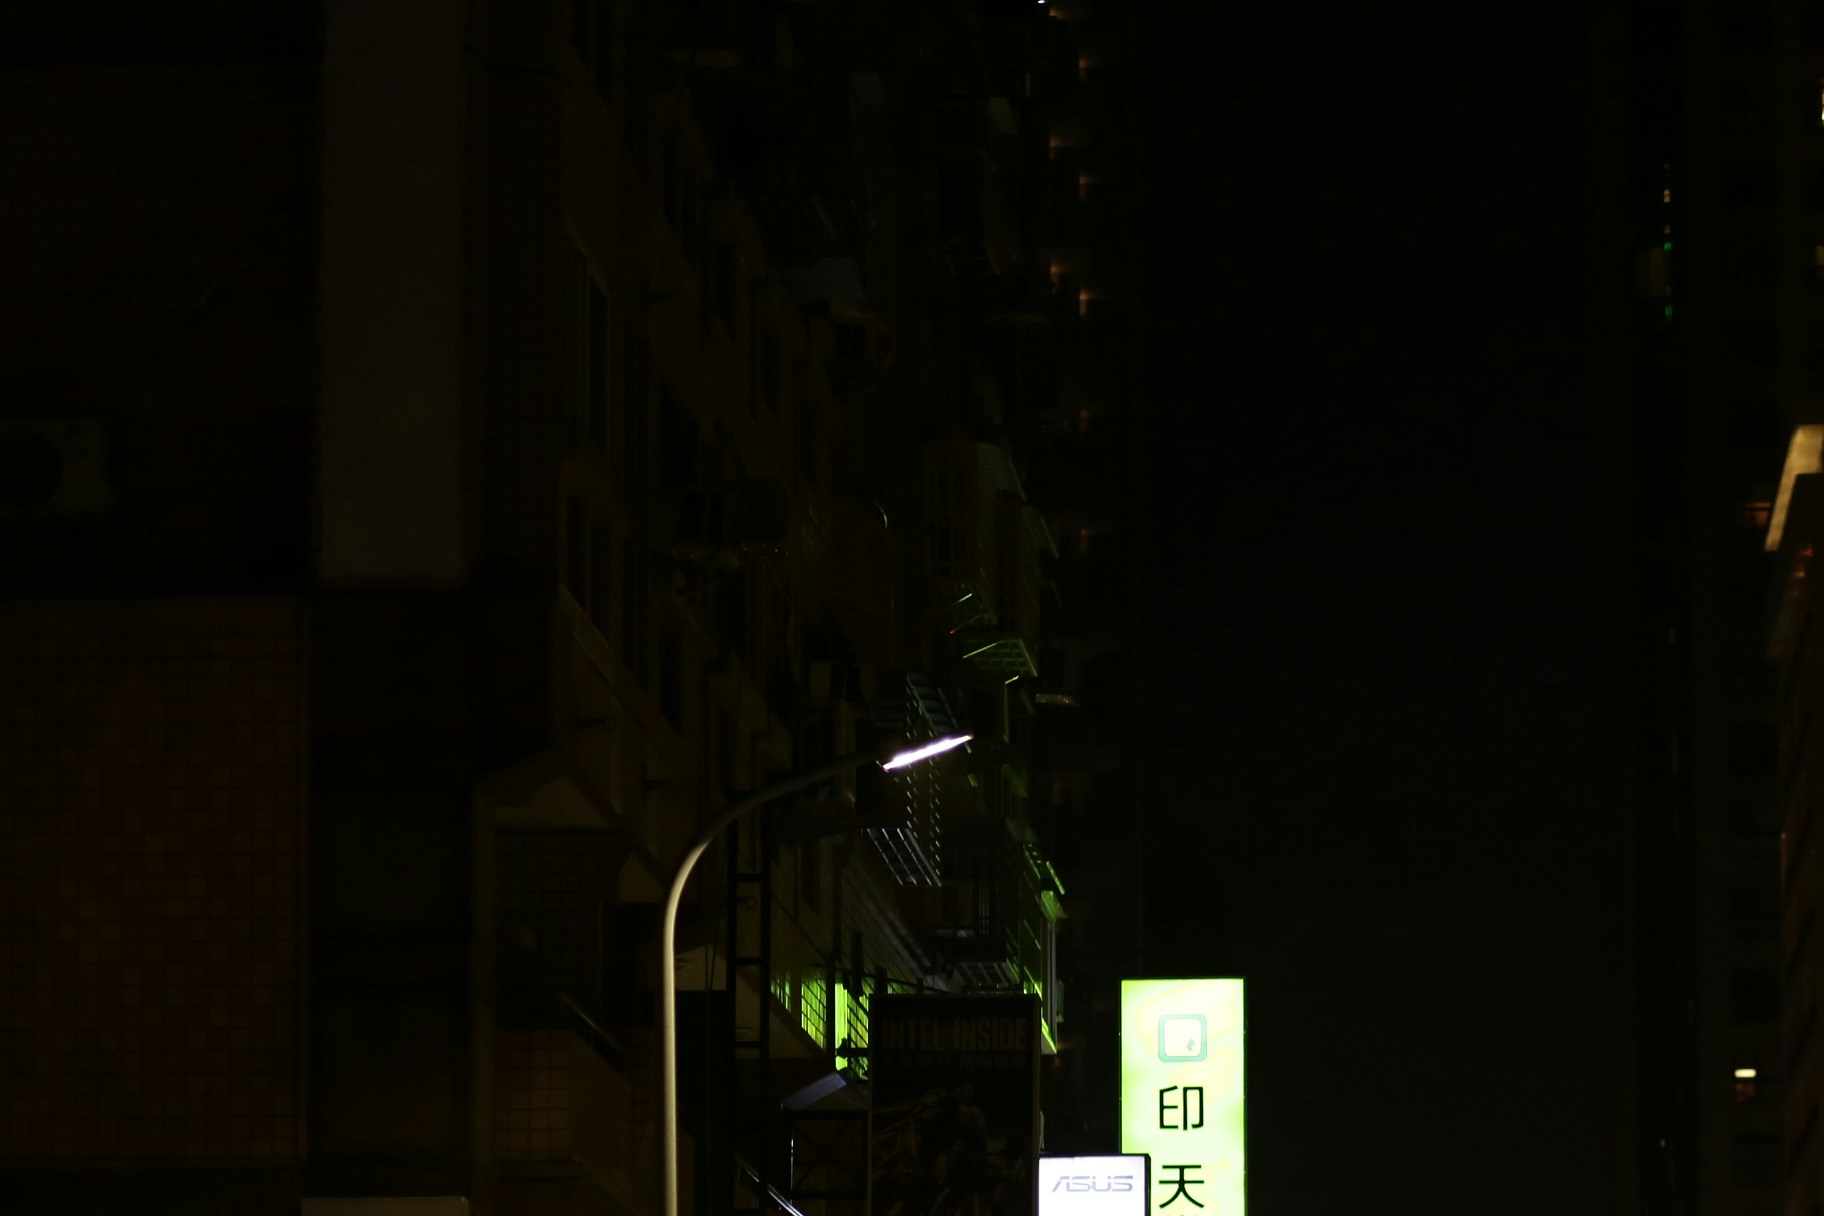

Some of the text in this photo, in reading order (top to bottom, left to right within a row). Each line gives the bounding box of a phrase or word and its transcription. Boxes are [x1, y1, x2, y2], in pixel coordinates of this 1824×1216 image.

[882, 1017, 1028, 1052] INTEL INSIDE
[1051, 1175, 1134, 1192] ASUS
